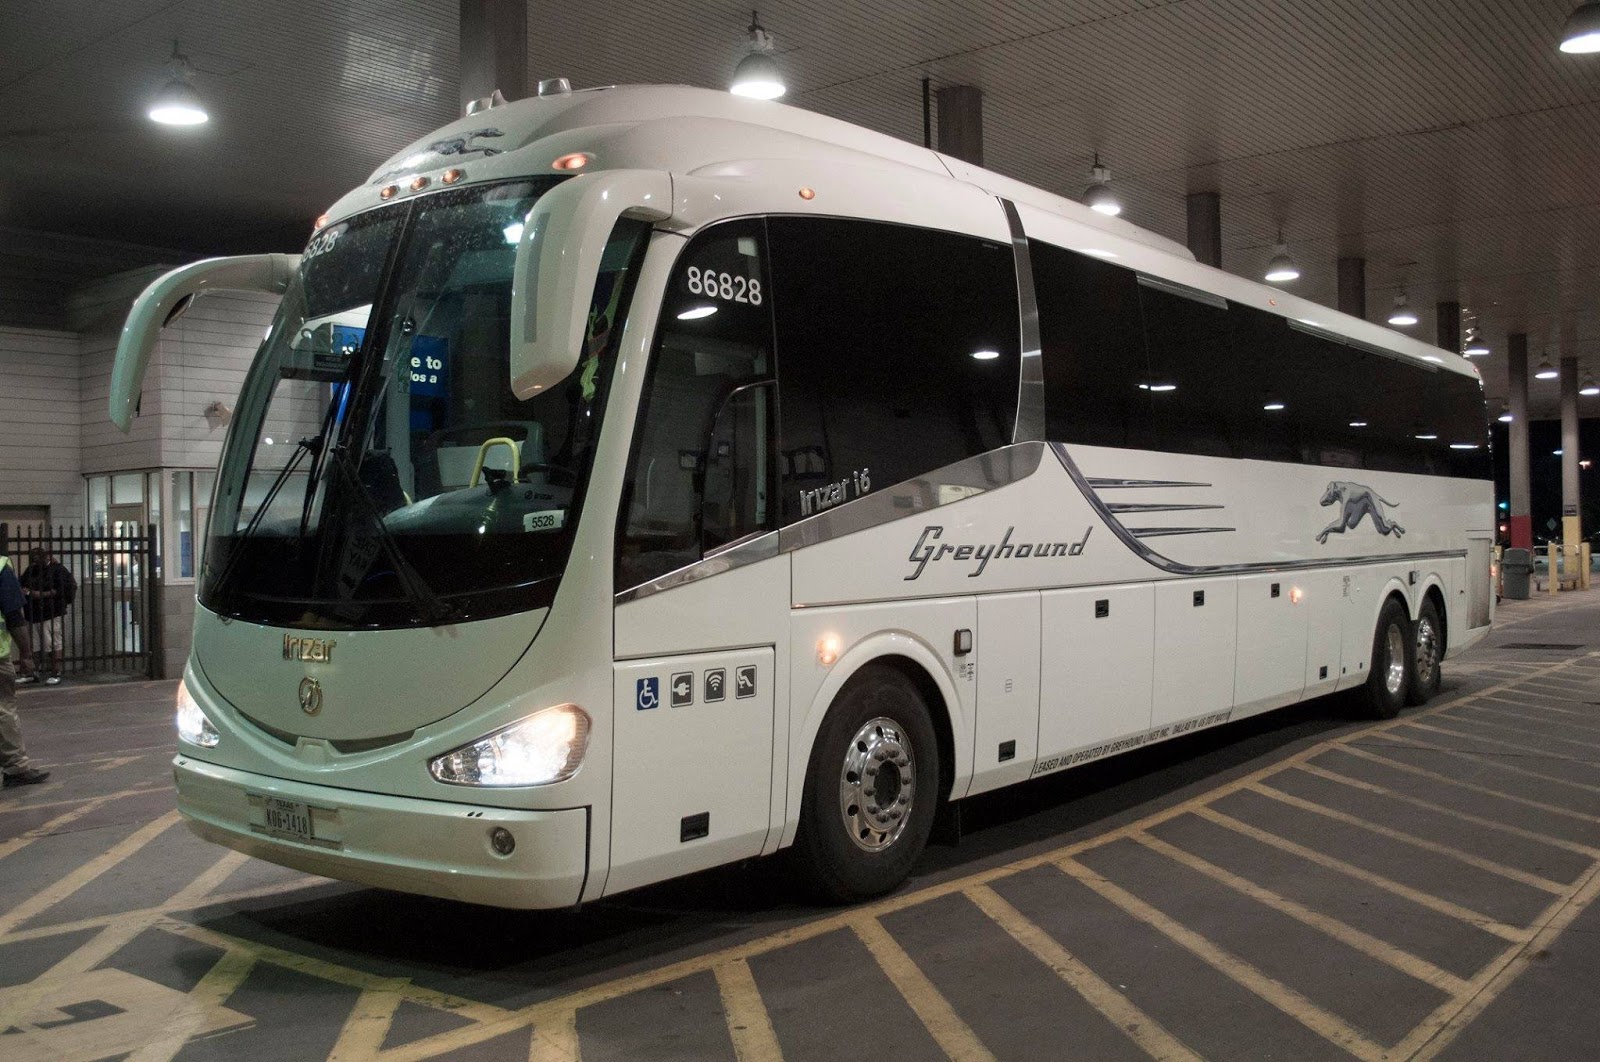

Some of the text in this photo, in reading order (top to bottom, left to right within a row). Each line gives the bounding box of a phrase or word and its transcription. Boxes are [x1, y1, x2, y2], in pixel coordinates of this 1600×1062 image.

[687, 265, 762, 306] 86828
[425, 355, 442, 370] to
[800, 467, 871, 517] Irizar i6
[531, 514, 555, 529] 5528
[903, 525, 1094, 581] Greyhound
[283, 632, 337, 664] Irizar
[1033, 758, 1059, 774] LEASED
[1058, 754, 1073, 767] AND
[1071, 745, 1103, 764] OPERATED
[1109, 735, 1144, 753] GREYHOUND
